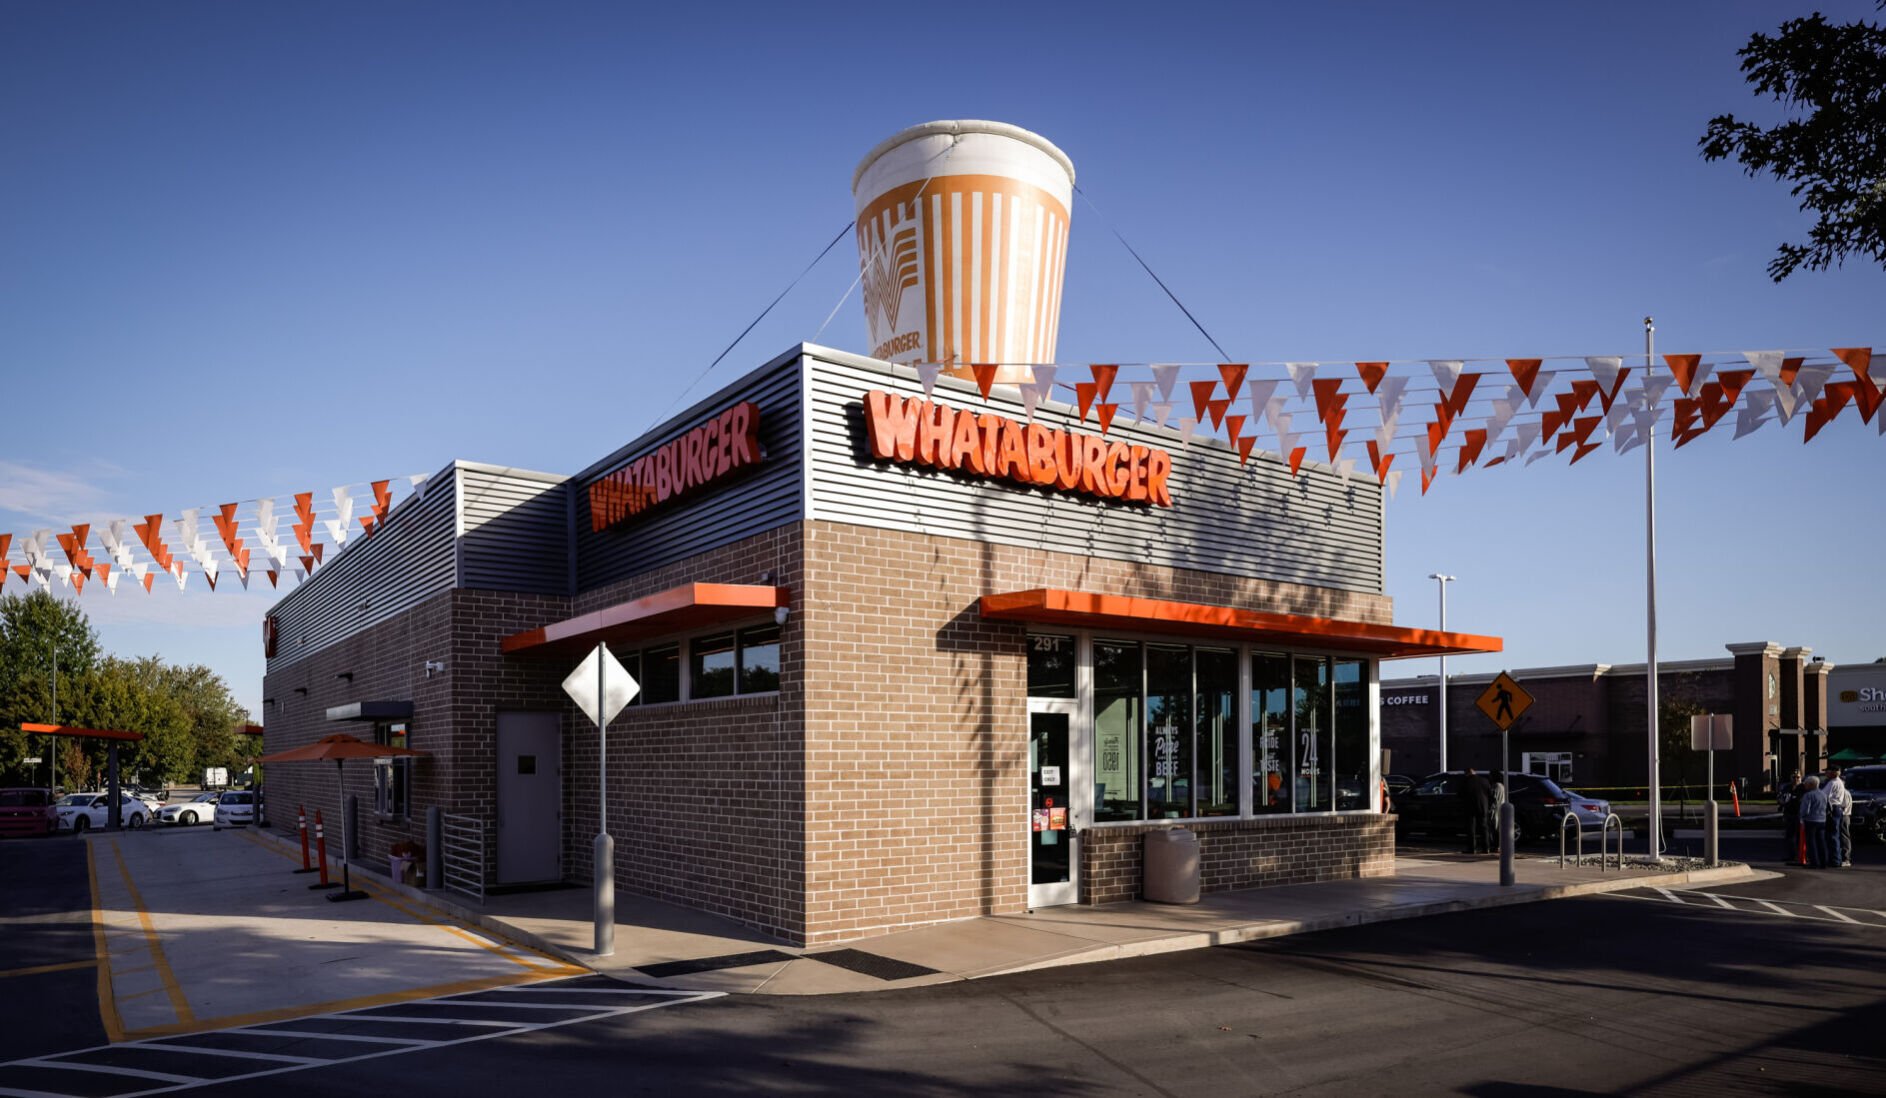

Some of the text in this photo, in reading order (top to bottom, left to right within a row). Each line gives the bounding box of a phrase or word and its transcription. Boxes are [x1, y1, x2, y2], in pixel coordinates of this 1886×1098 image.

[863, 390, 1173, 508] WHATABURGER
[589, 401, 762, 533] WHATABURGER
[1034, 636, 1059, 652] 291
[1386, 695, 1429, 706] COFFEE
[1859, 687, 1886, 702] Sh
[1154, 736, 1180, 757] Pure
[1301, 732, 1318, 767] 24
[1155, 761, 1179, 776] BEEF
[1300, 767, 1320, 775] HOURS
